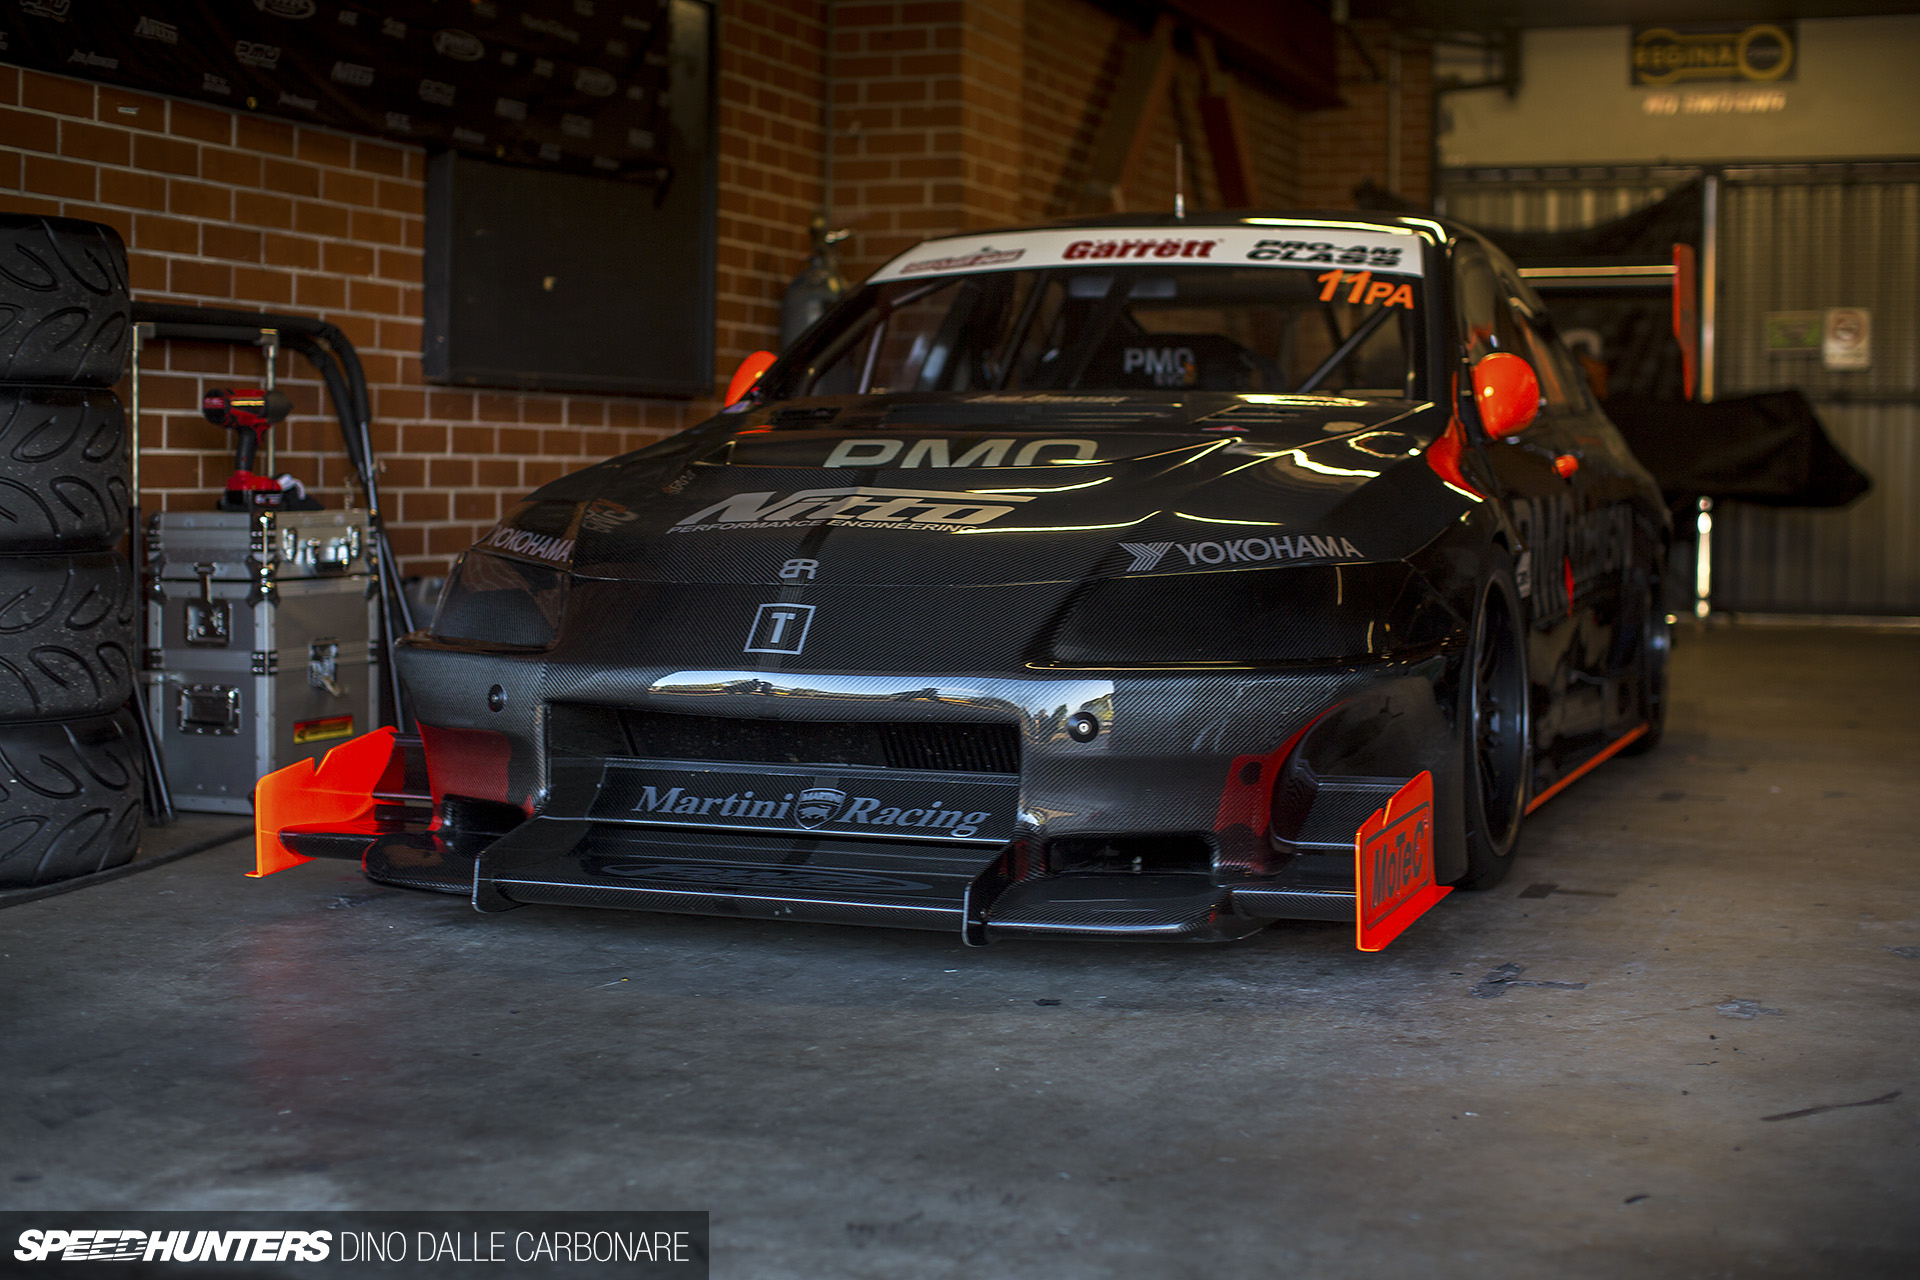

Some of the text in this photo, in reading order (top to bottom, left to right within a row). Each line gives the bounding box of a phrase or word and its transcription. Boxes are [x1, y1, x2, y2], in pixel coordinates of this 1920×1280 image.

[1062, 239, 1217, 260] Garrett
[1247, 249, 1401, 266] CLASS
[1254, 240, 1403, 255] PRO-AM
[666, 519, 980, 534] PERFORMANCE ENGINEERING
[488, 526, 575, 562] YOKOHAMA
[1175, 535, 1365, 565] YOKOHAMA
[631, 786, 991, 837] Martini Racing
[1372, 820, 1425, 909] MoTeC
